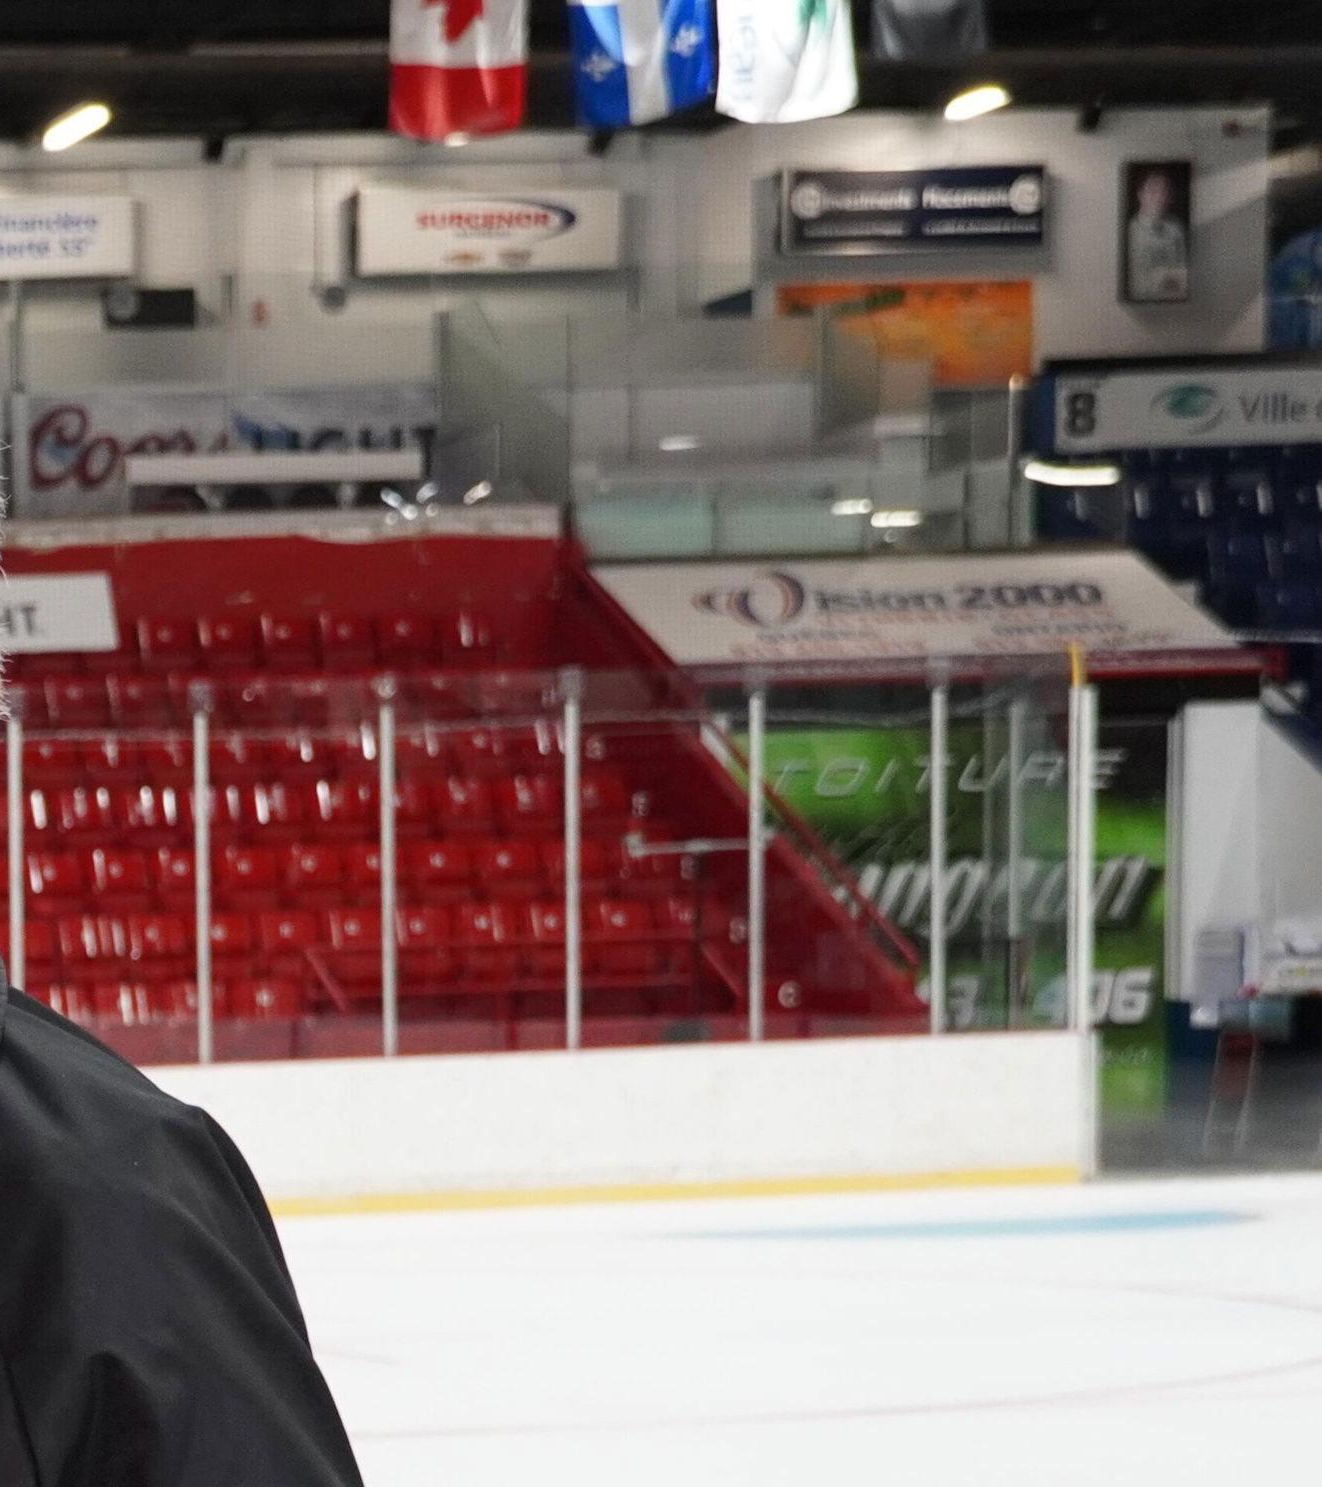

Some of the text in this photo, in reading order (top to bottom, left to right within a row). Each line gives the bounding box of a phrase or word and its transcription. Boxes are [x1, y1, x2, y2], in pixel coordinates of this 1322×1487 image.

[1064, 392, 1097, 437] 8
[1239, 392, 1305, 424] Ville
[958, 583, 1103, 609] 2000
